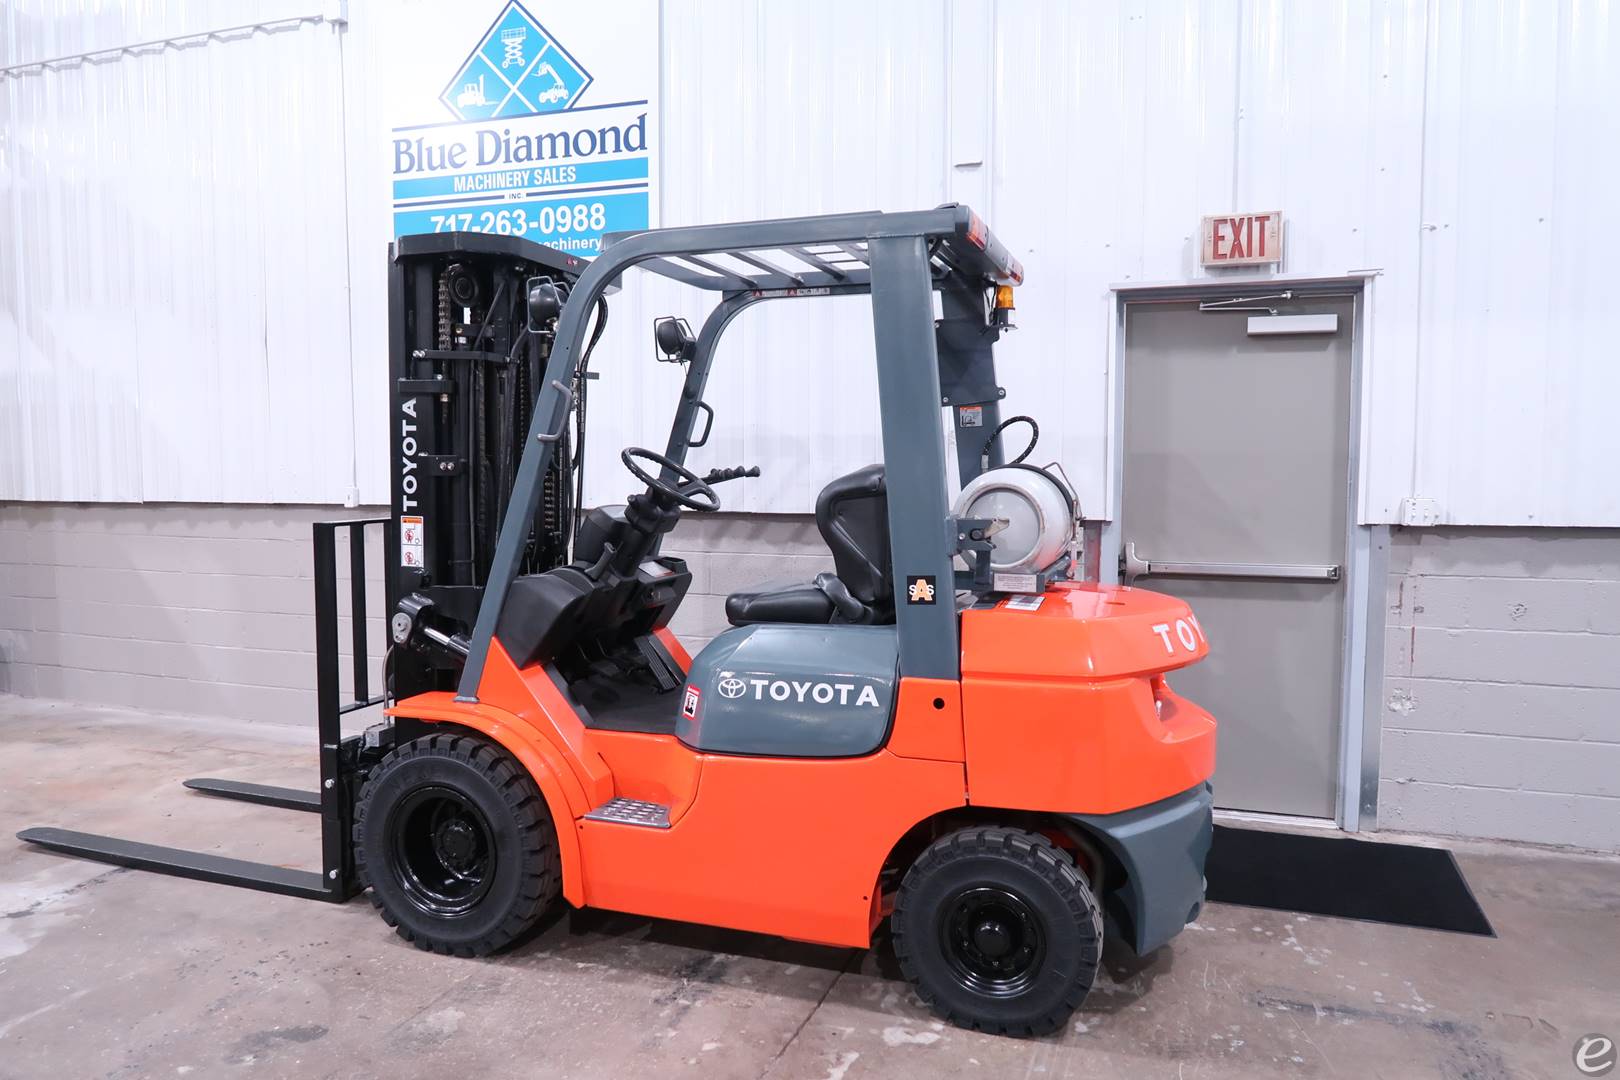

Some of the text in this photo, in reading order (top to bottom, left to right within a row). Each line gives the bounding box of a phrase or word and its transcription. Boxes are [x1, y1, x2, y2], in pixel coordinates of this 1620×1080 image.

[393, 113, 648, 174] Blue Diamond
[454, 166, 576, 192] MACHINERY SALES
[508, 192, 524, 200] INC.
[431, 203, 606, 235] 717-263-0988
[1212, 215, 1270, 260] EXIT
[402, 397, 418, 512] TOYOTA
[750, 679, 880, 707] TOYOTA
